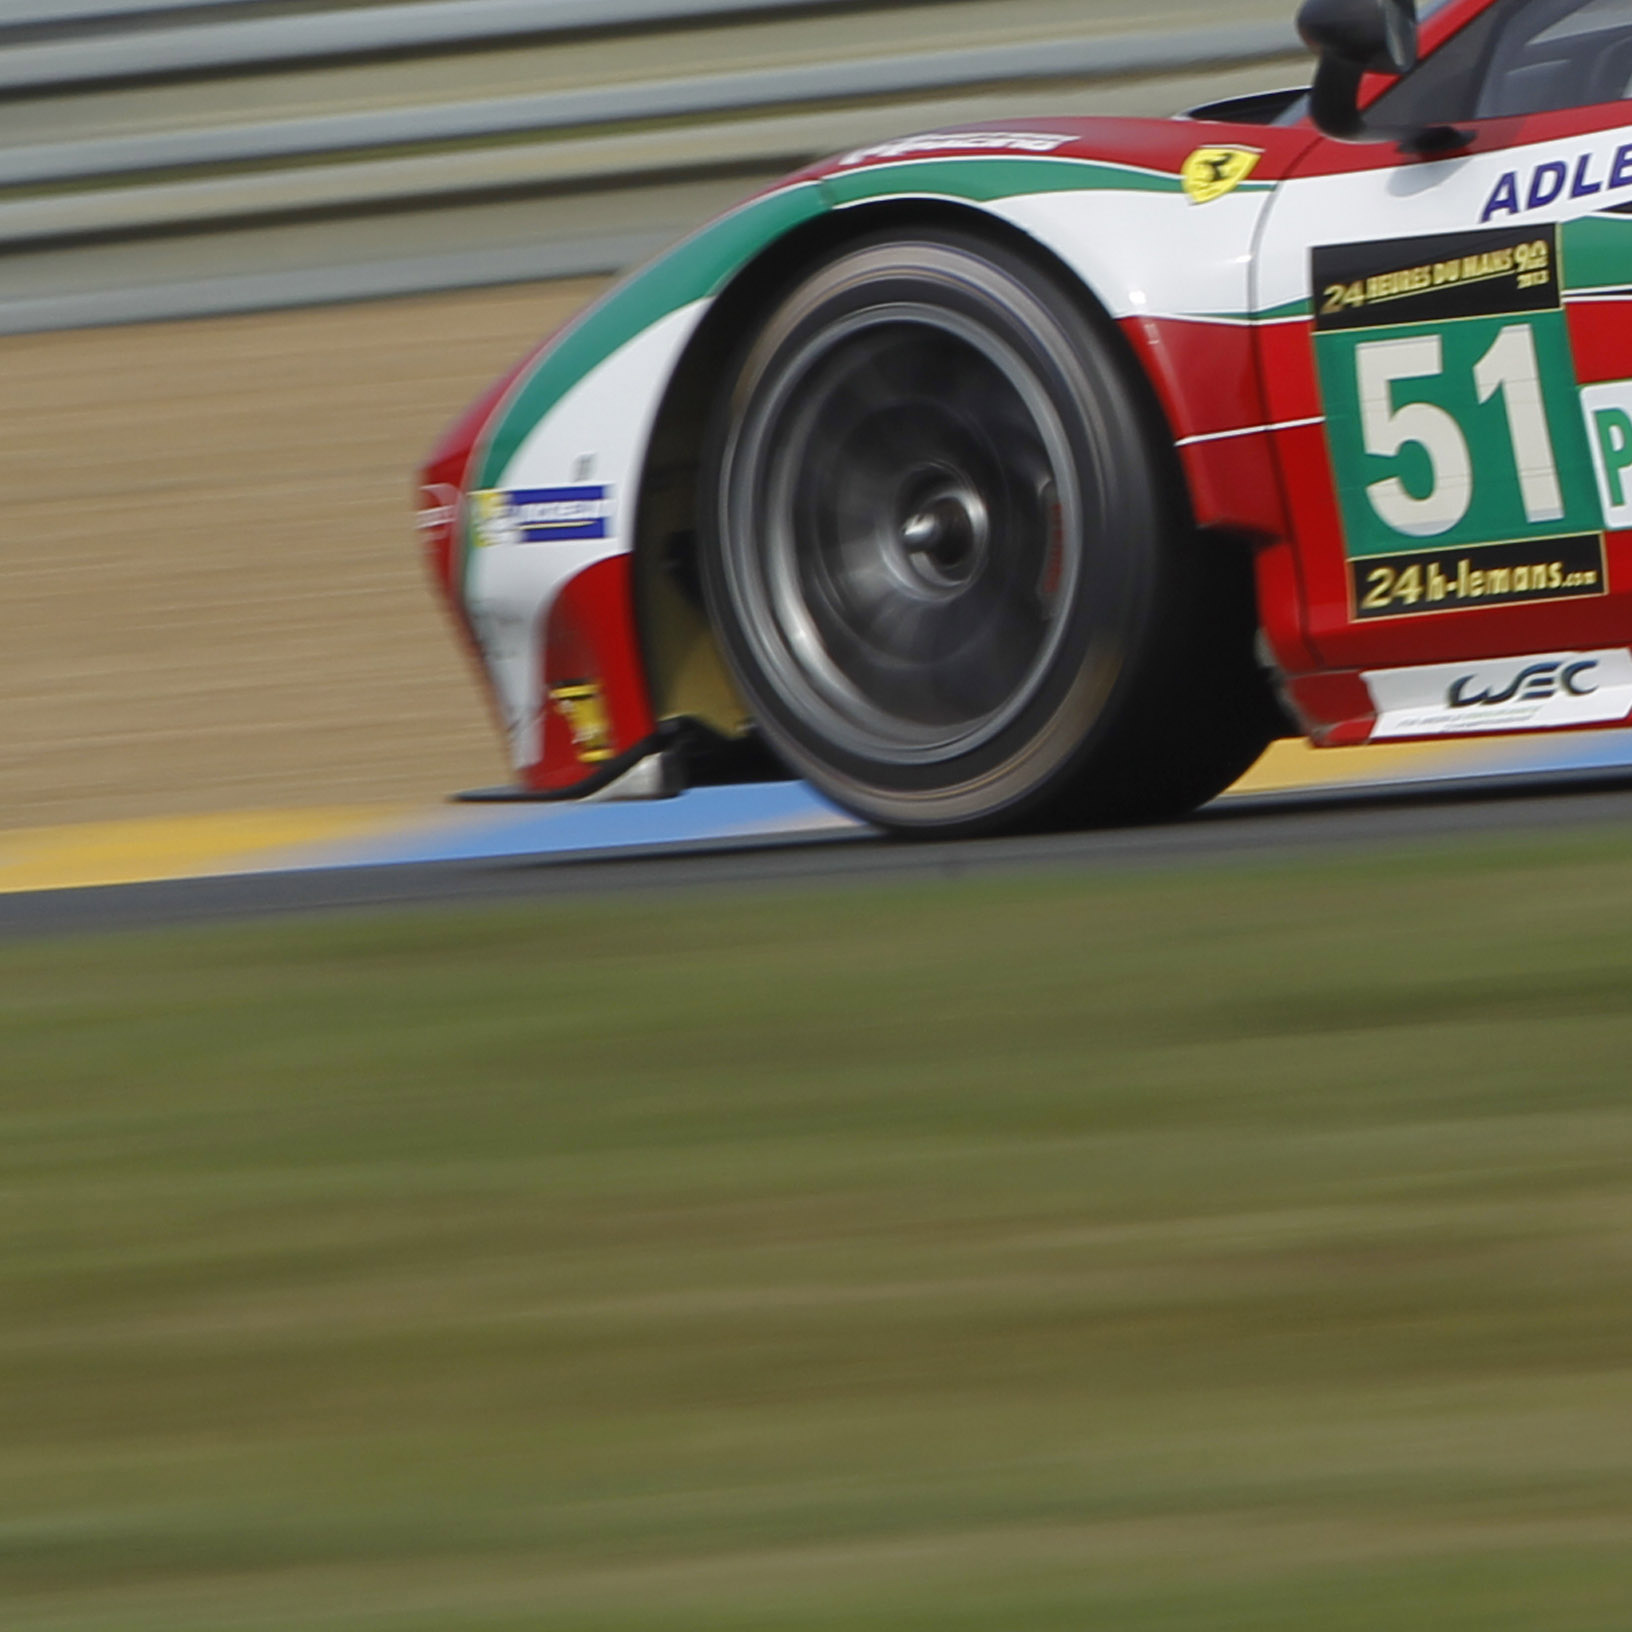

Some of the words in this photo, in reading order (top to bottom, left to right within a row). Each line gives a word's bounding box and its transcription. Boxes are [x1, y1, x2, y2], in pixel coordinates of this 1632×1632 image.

[1321, 282, 1365, 314] 24
[1355, 323, 1563, 536] 51
[1446, 659, 1599, 708] WEC
